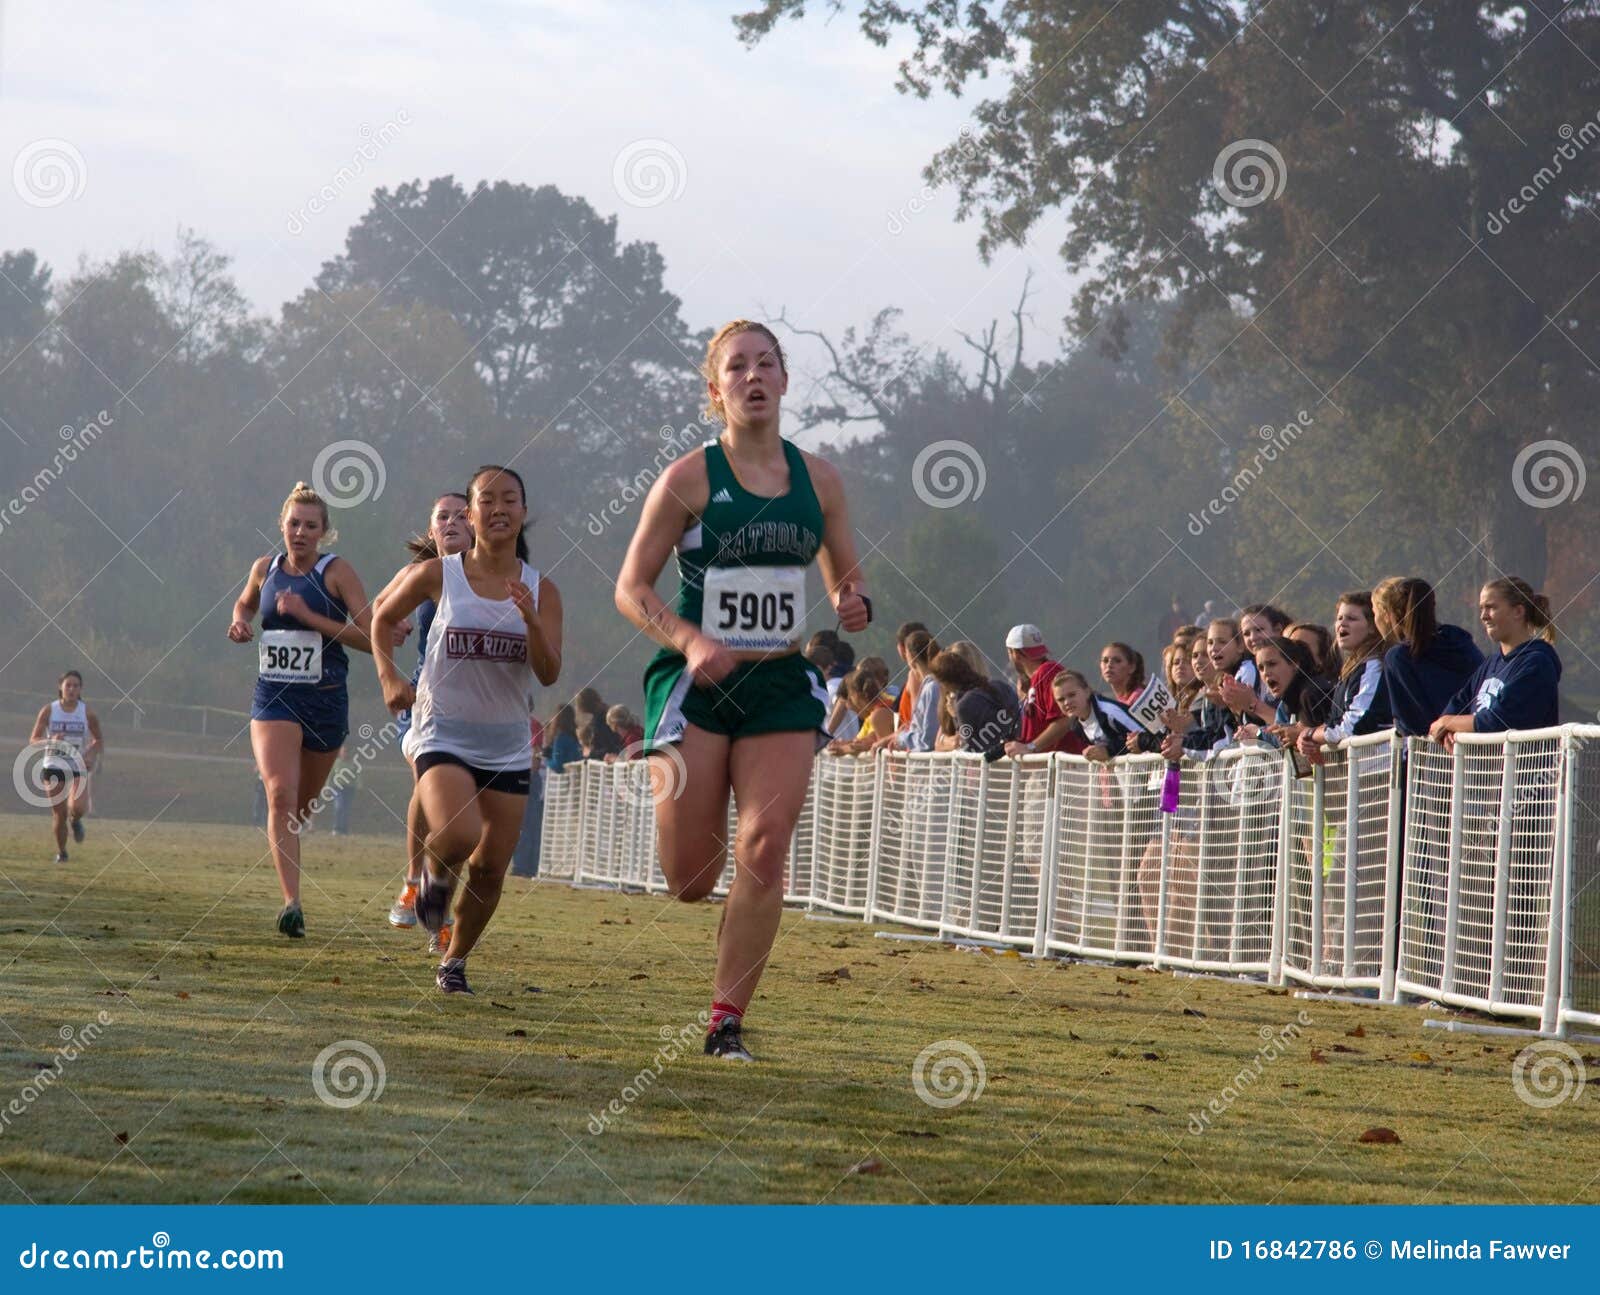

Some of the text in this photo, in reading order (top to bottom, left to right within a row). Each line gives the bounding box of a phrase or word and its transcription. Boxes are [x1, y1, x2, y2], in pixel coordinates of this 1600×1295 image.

[718, 591, 795, 630] 5905
[448, 633, 477, 653] OAK
[267, 646, 314, 671] 5827
